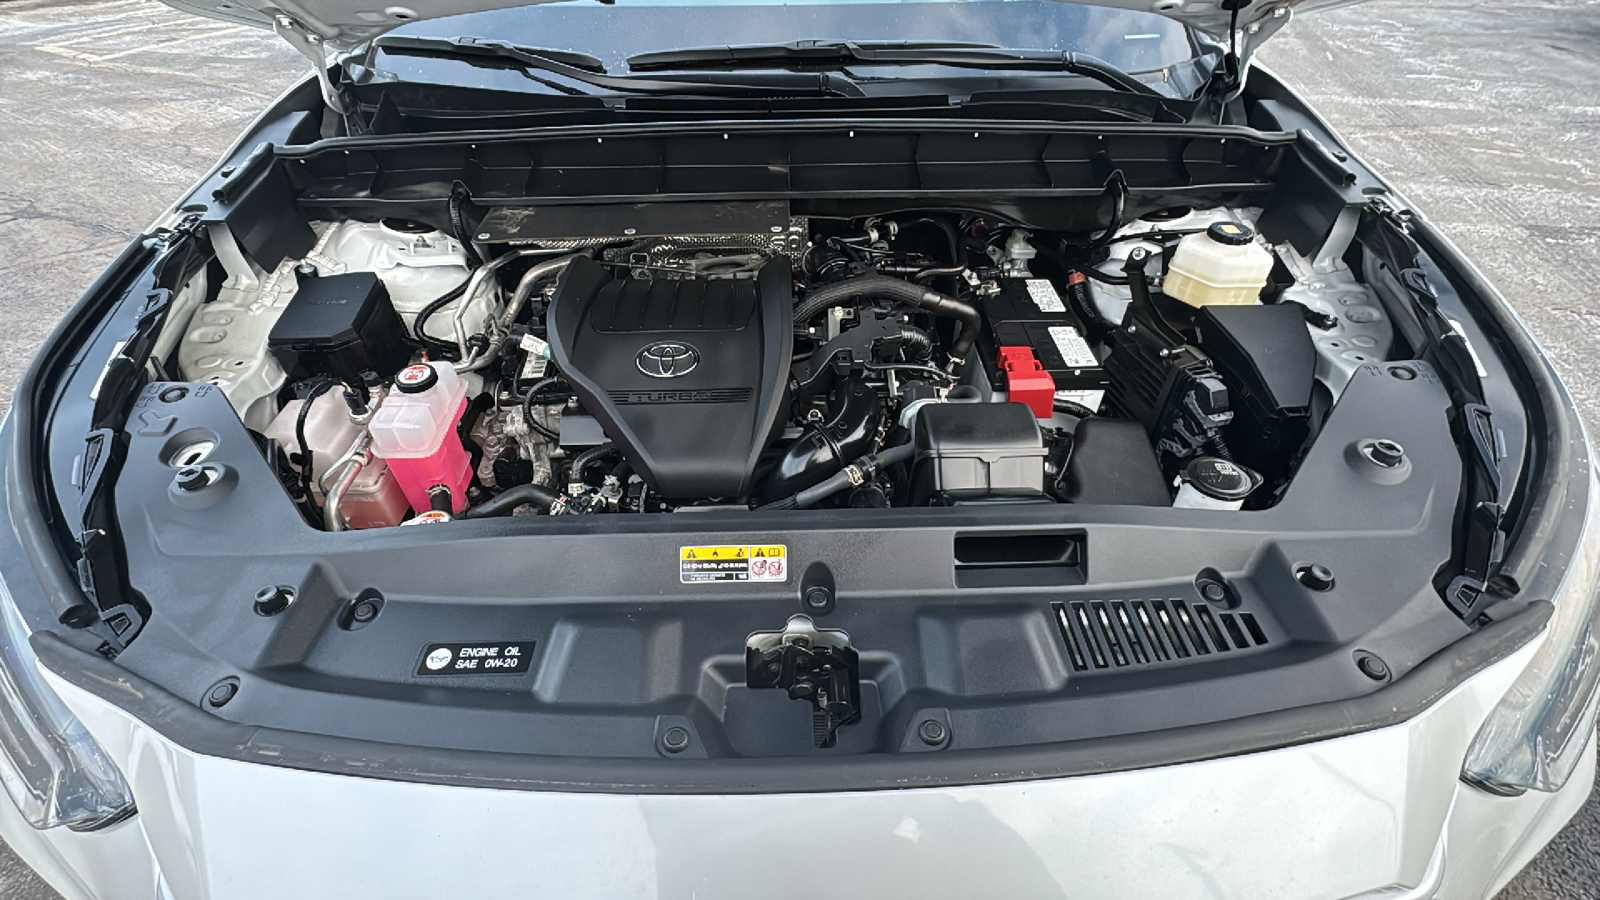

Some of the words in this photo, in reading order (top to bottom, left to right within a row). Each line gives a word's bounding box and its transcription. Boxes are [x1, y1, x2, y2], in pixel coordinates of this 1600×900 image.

[629, 391, 711, 402] TURBO
[460, 648, 498, 656] ENGINE
[504, 646, 521, 656] OIL
[455, 660, 478, 668] SAE
[484, 658, 518, 668] 0W-20
